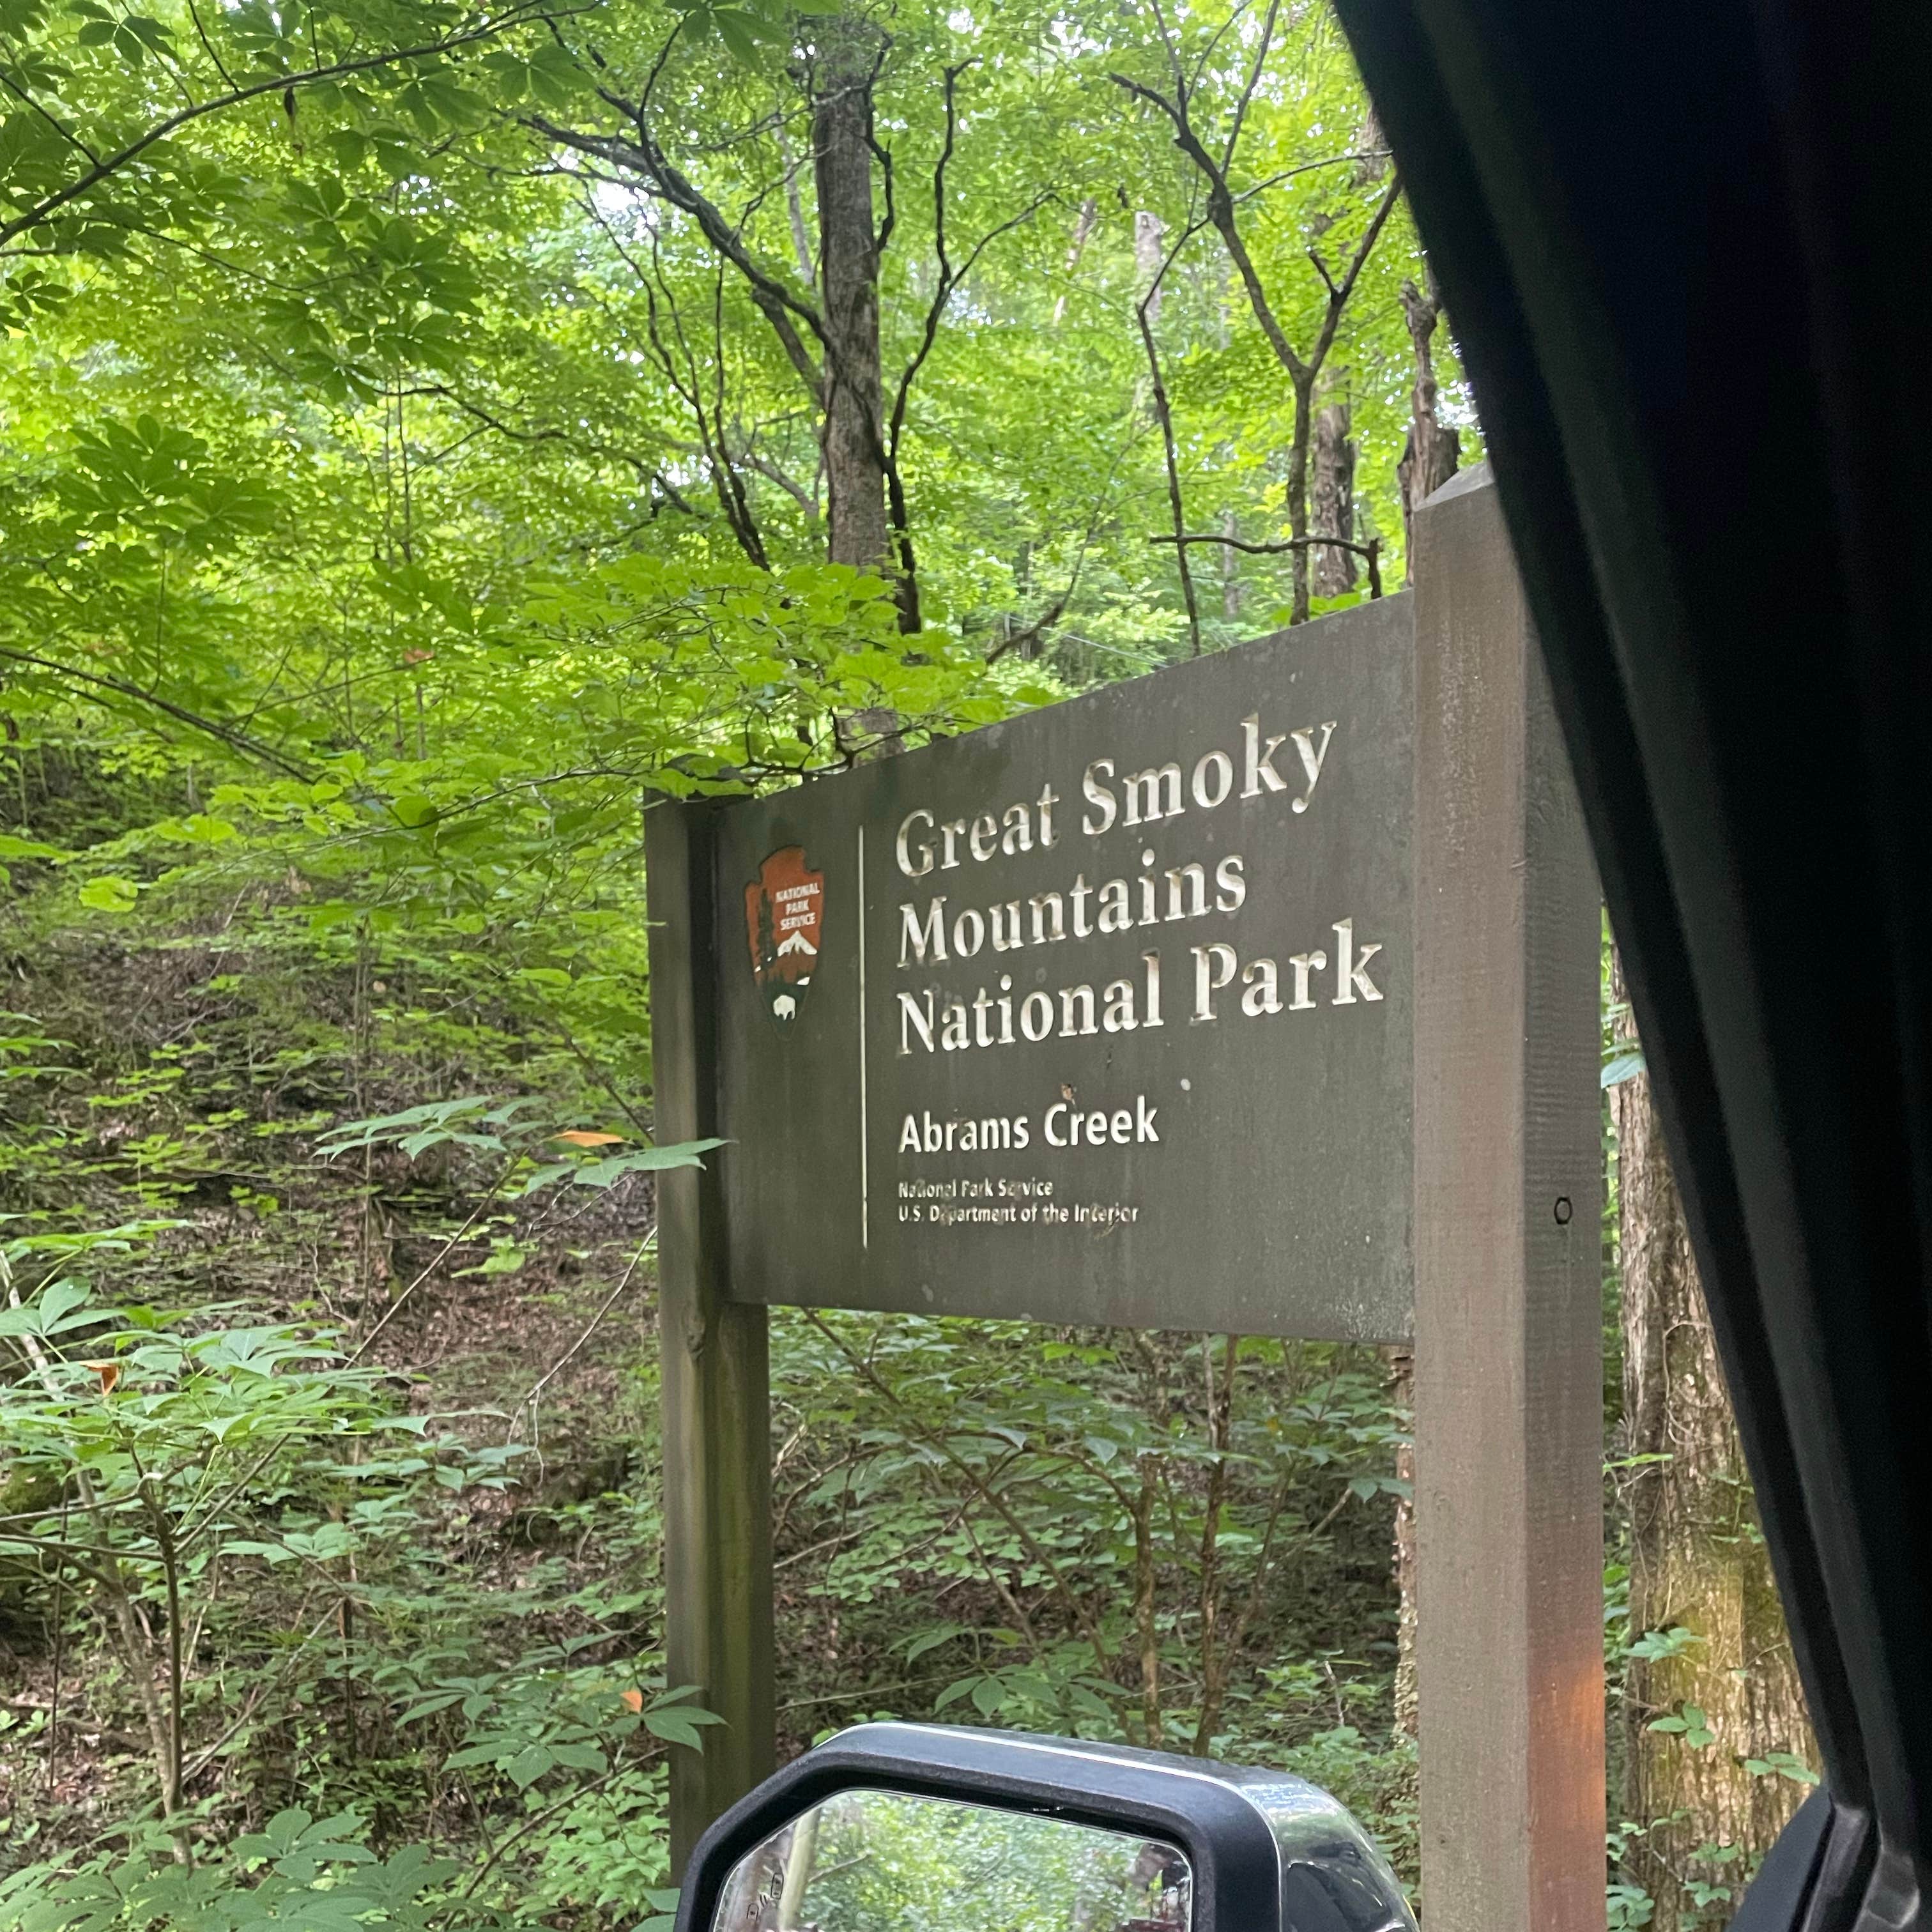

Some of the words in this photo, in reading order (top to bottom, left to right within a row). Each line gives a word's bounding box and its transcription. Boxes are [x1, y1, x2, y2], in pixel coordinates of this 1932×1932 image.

[896, 783, 1060, 878] Great
[1082, 712, 1337, 835] Smoky
[776, 882, 820, 903] NATIONAL
[785, 900, 809, 916] PARK
[896, 848, 1246, 969] Mountains
[780, 912, 816, 930] SERVICE
[896, 950, 1165, 1055] National
[1190, 918, 1384, 1025] Park
[898, 1110, 1029, 1153] Abrams
[1044, 1095, 1160, 1147] Creek
[898, 1178, 956, 1199] National
[961, 1177, 994, 1197] Park
[997, 1176, 1054, 1197] Service
[1020, 1202, 1038, 1222] of
[1042, 1202, 1070, 1223] the
[1074, 1202, 1139, 1225] Interior
